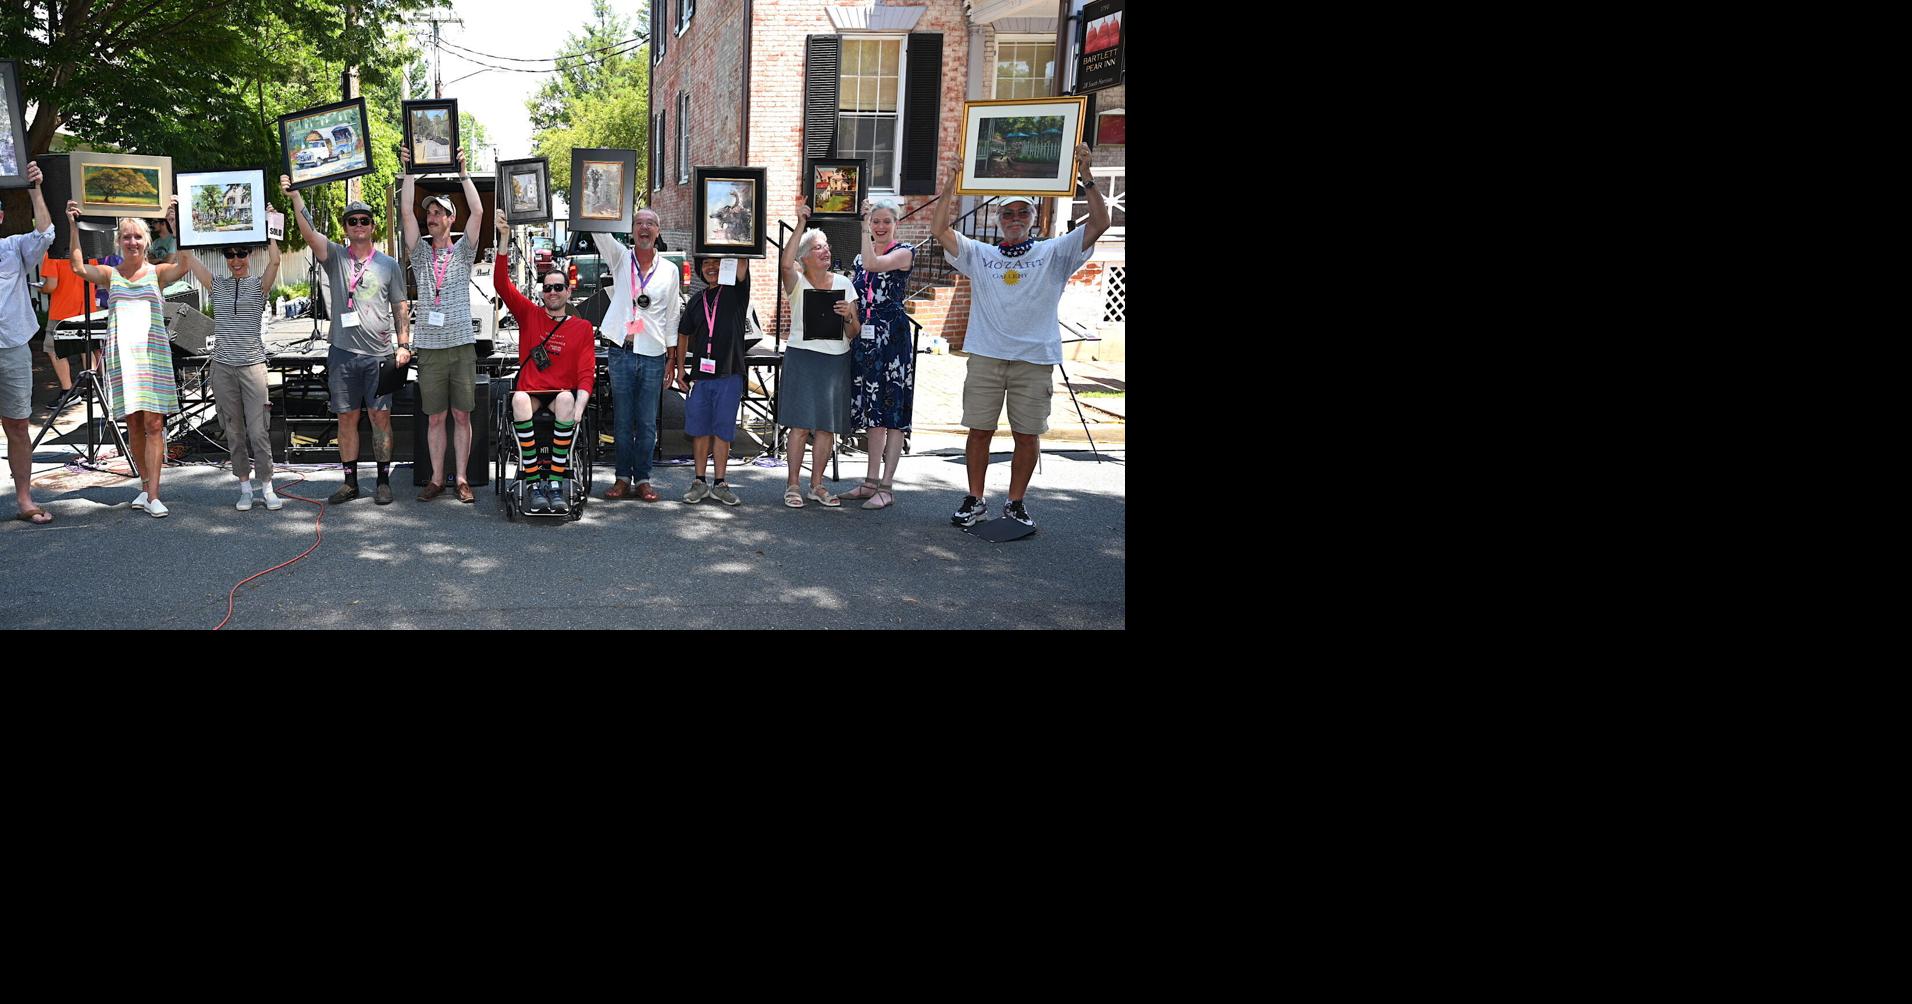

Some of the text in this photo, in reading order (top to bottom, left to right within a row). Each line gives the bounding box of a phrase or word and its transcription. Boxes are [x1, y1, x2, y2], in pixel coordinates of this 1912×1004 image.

[1083, 48, 1118, 64] BARTLETT
[1086, 58, 1116, 72] PEAR INN
[269, 228, 282, 237] SOLD
